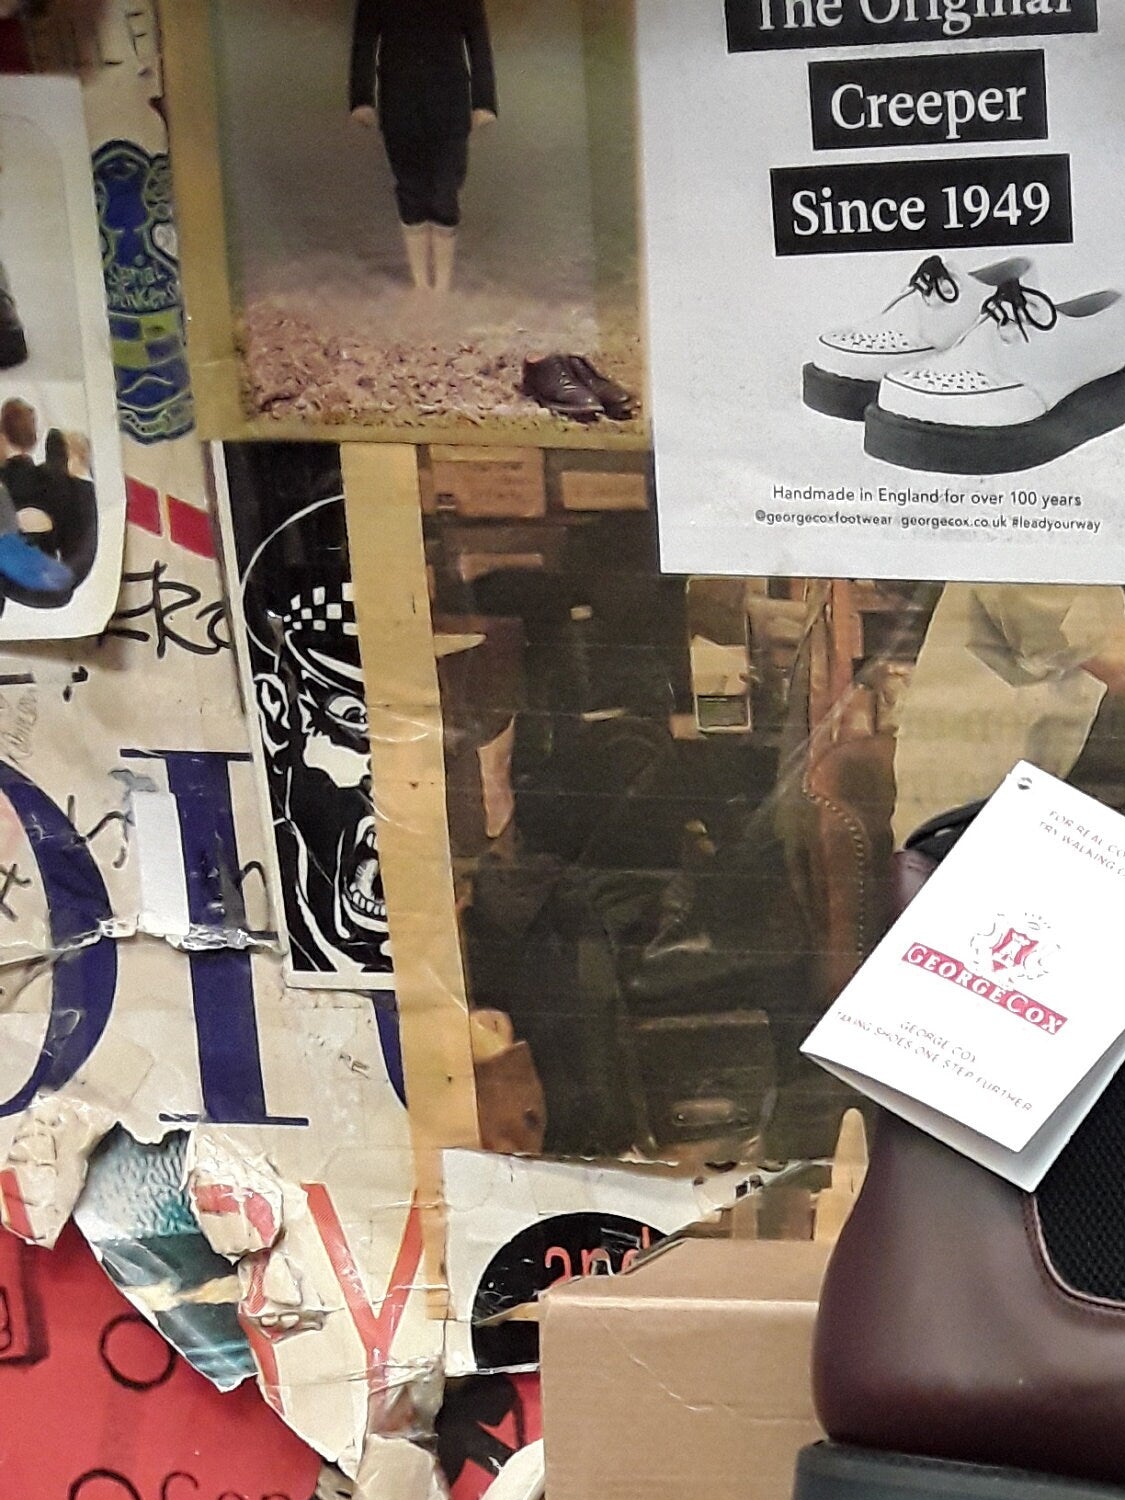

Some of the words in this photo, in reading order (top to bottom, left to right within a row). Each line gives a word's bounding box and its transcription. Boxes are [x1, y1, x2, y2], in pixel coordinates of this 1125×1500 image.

[860, 0, 1073, 36] Origin
[831, 83, 1026, 139] Creeper
[792, 187, 927, 236] Since
[942, 182, 1050, 229] 1949
[773, 485, 855, 501] Handmade
[860, 487, 872, 501] in
[879, 488, 939, 506] England
[943, 488, 965, 504] for
[971, 493, 1004, 504] over
[1011, 492, 1037, 504] 100
[1042, 493, 1082, 508] years
[755, 509, 892, 526] @georgecoxfootwear
[1012, 517, 1101, 533] #leadyourway
